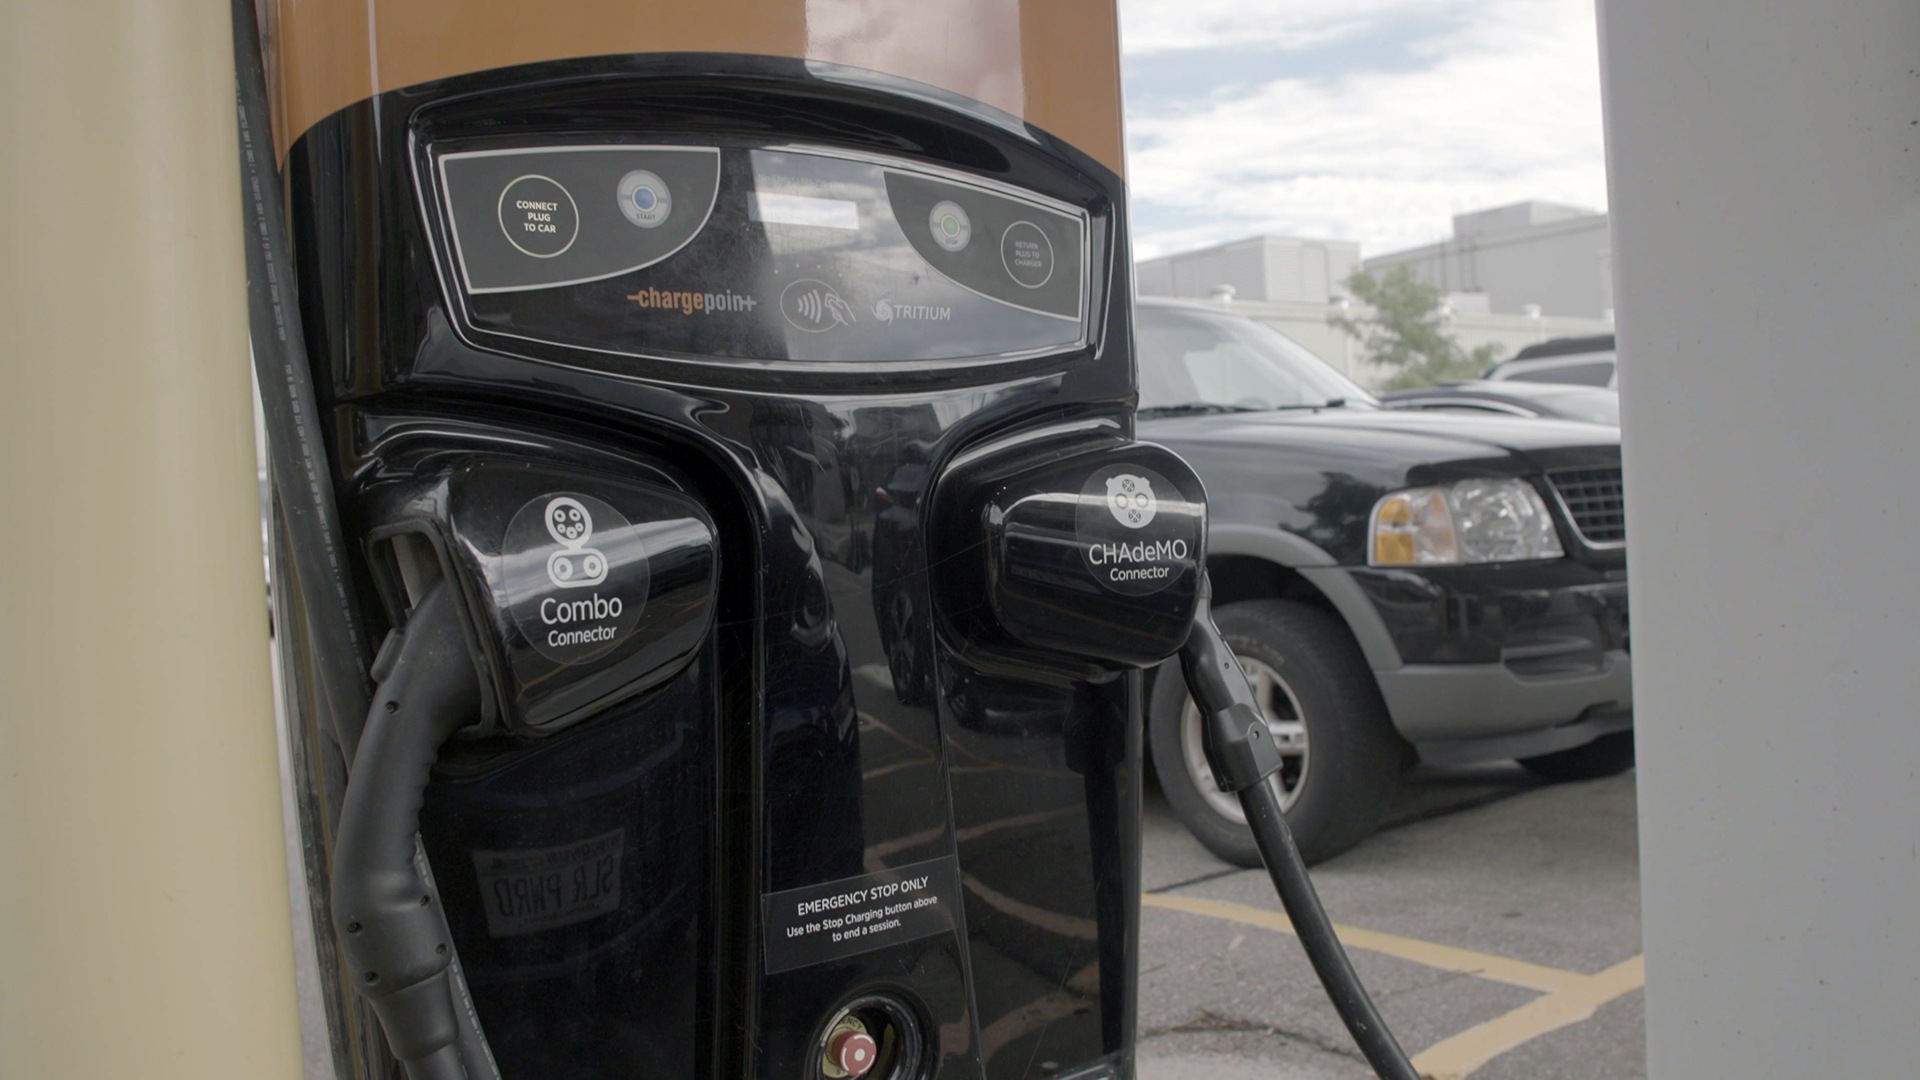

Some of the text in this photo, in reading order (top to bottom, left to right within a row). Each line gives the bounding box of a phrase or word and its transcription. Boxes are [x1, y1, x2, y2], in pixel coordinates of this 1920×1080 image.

[516, 200, 558, 211] CONNECT
[527, 211, 551, 222] PLUG
[523, 222, 557, 233] TO CAR
[1031, 251, 1041, 259] TO
[893, 304, 951, 321] TRITIUM
[1089, 539, 1187, 565] CHAdeMO
[1110, 566, 1170, 582] Connector
[540, 592, 623, 625] Combo
[547, 625, 617, 647] Connector
[797, 876, 929, 916] EMERGENCY STOP ONLY
[786, 896, 938, 938] Use the Stop Charging button above
[832, 919, 902, 942] to end a session.
